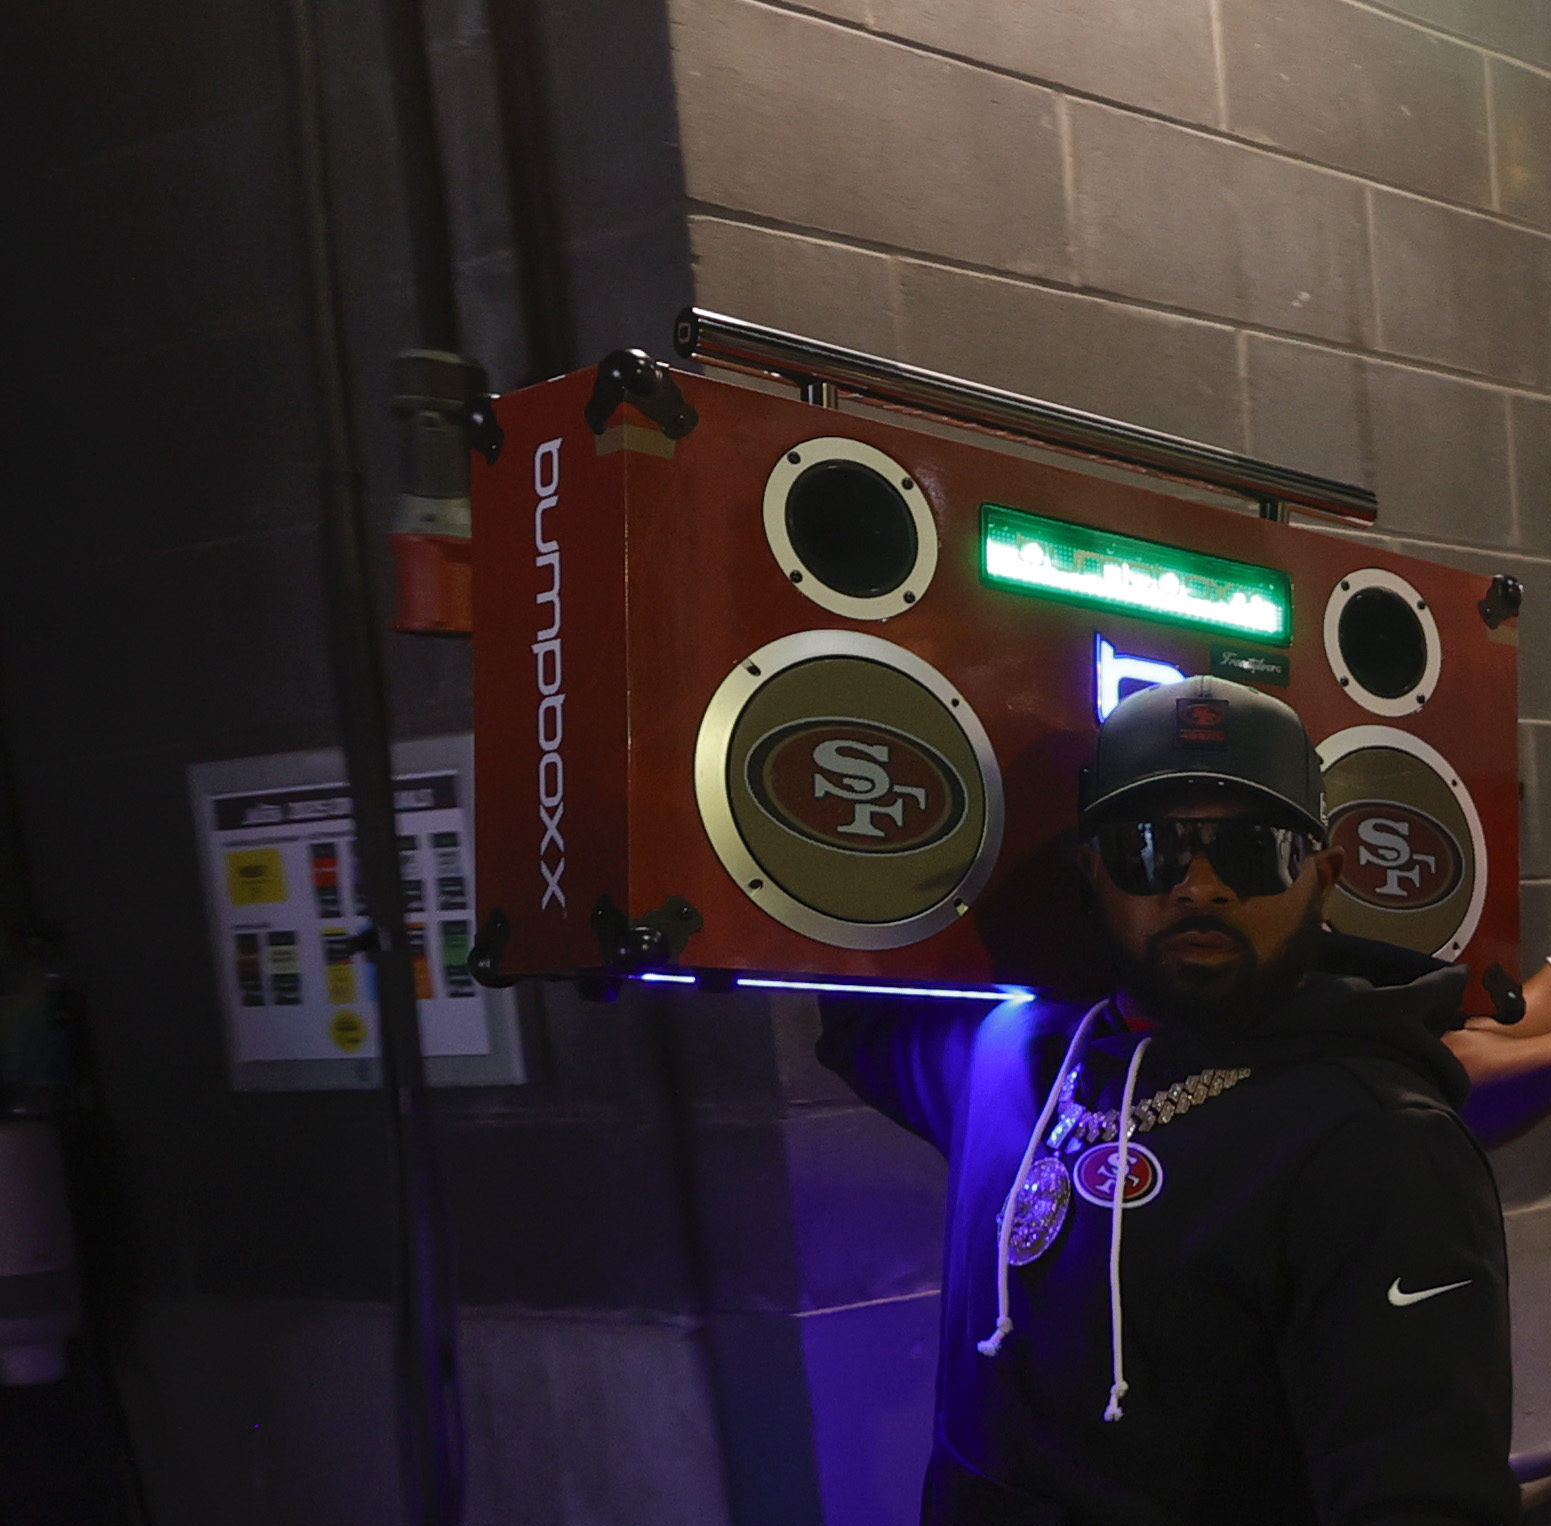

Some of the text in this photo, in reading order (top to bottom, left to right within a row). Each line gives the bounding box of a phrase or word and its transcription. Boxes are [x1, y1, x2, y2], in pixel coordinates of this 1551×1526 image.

[531, 437, 568, 911] bumpboxx
[812, 739, 928, 838] SF
[1357, 818, 1437, 897] SF
